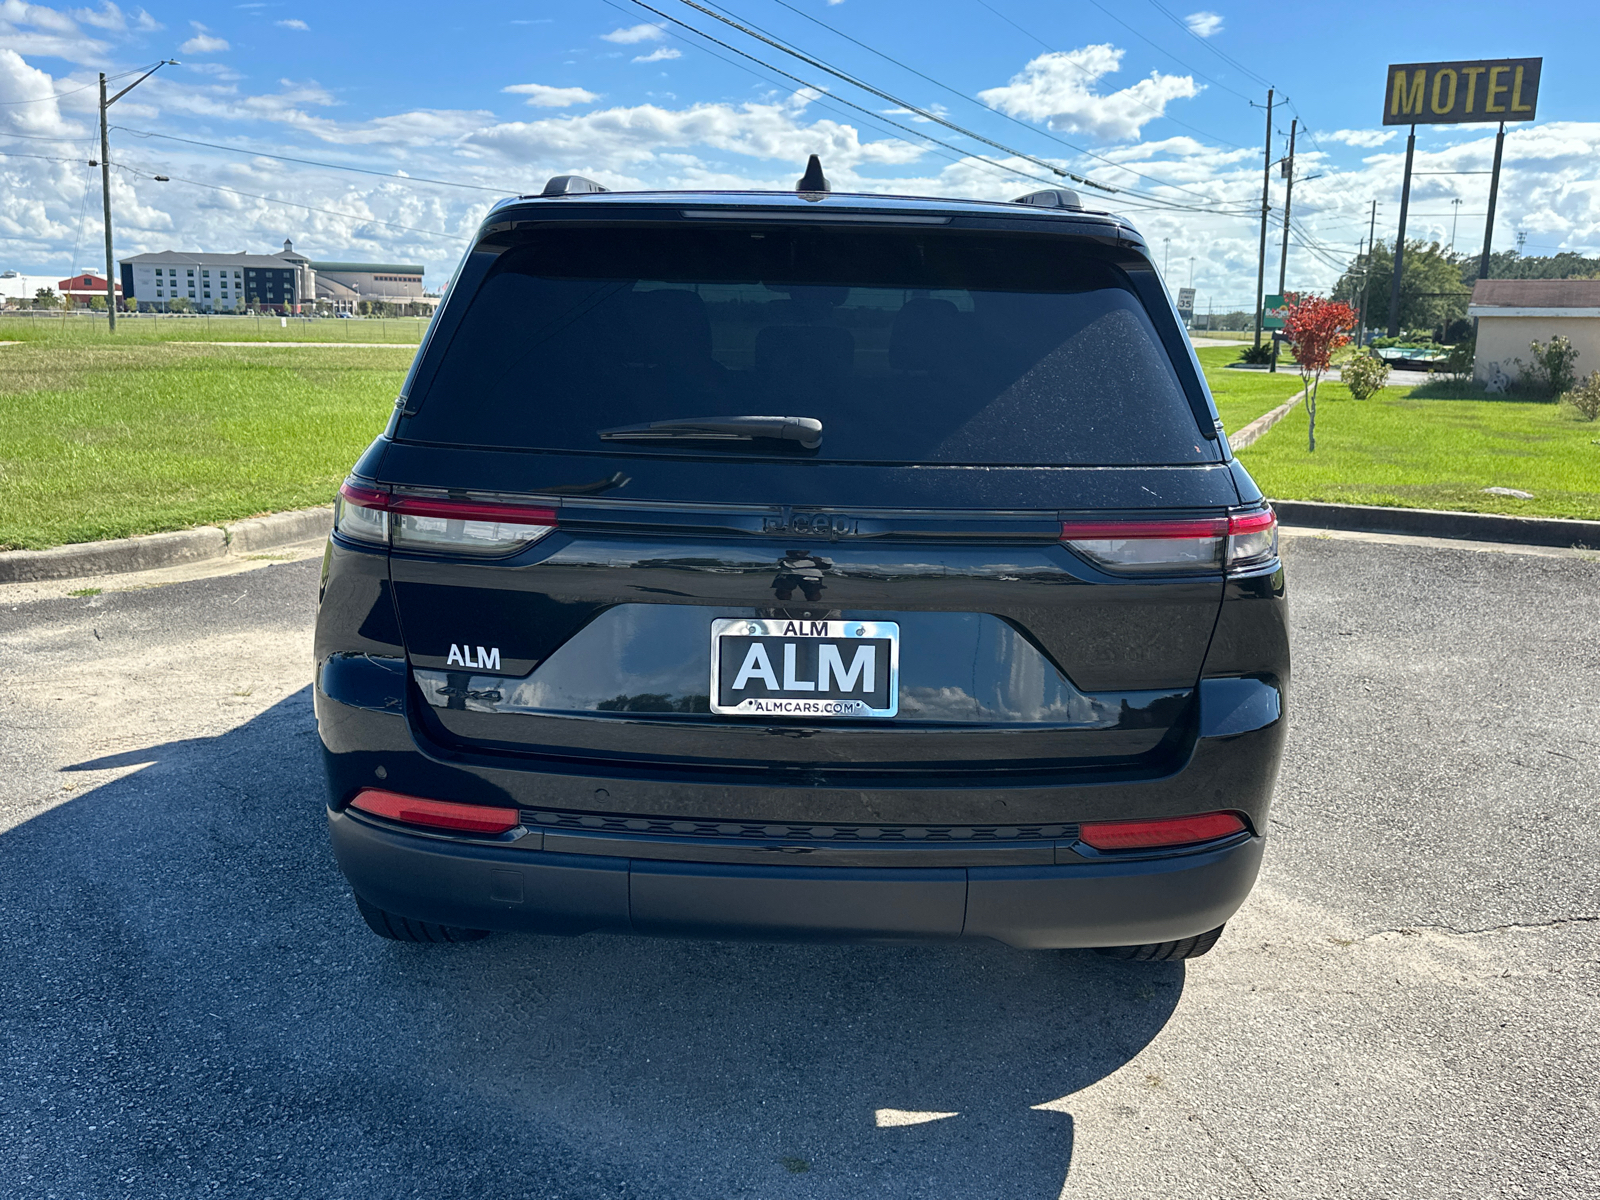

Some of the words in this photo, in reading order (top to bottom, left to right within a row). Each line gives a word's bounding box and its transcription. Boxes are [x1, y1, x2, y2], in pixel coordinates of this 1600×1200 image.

[1391, 65, 1531, 116] MOTEL
[1179, 300, 1191, 308] 35
[767, 506, 850, 543] Jeep
[784, 620, 828, 636] ALM
[447, 644, 500, 669] ALM
[732, 642, 876, 692] ALM
[755, 701, 854, 714] ALMCARS.COM
